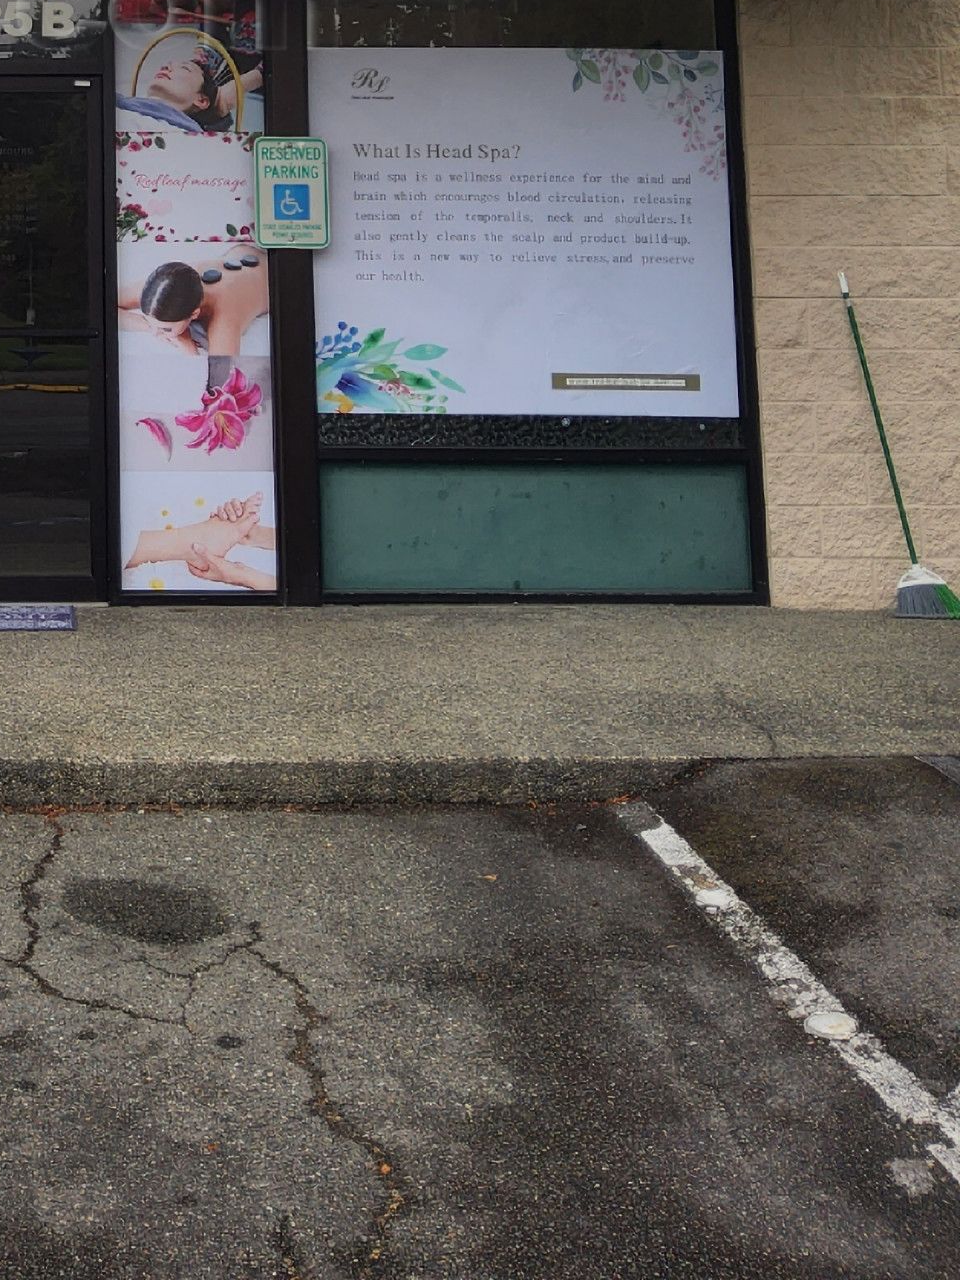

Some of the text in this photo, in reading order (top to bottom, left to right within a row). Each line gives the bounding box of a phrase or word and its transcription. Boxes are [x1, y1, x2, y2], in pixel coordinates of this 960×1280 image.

[42, 1, 76, 38] B
[261, 147, 321, 160] RESERVED
[353, 144, 521, 162] What Is Head Spa?
[264, 165, 319, 179] PARKING
[509, 173, 574, 184] experience
[583, 173, 601, 183] for
[611, 173, 629, 184] the
[354, 191, 386, 202] brain
[394, 192, 427, 202] which
[508, 193, 540, 203] blood
[553, 233, 572, 243] and
